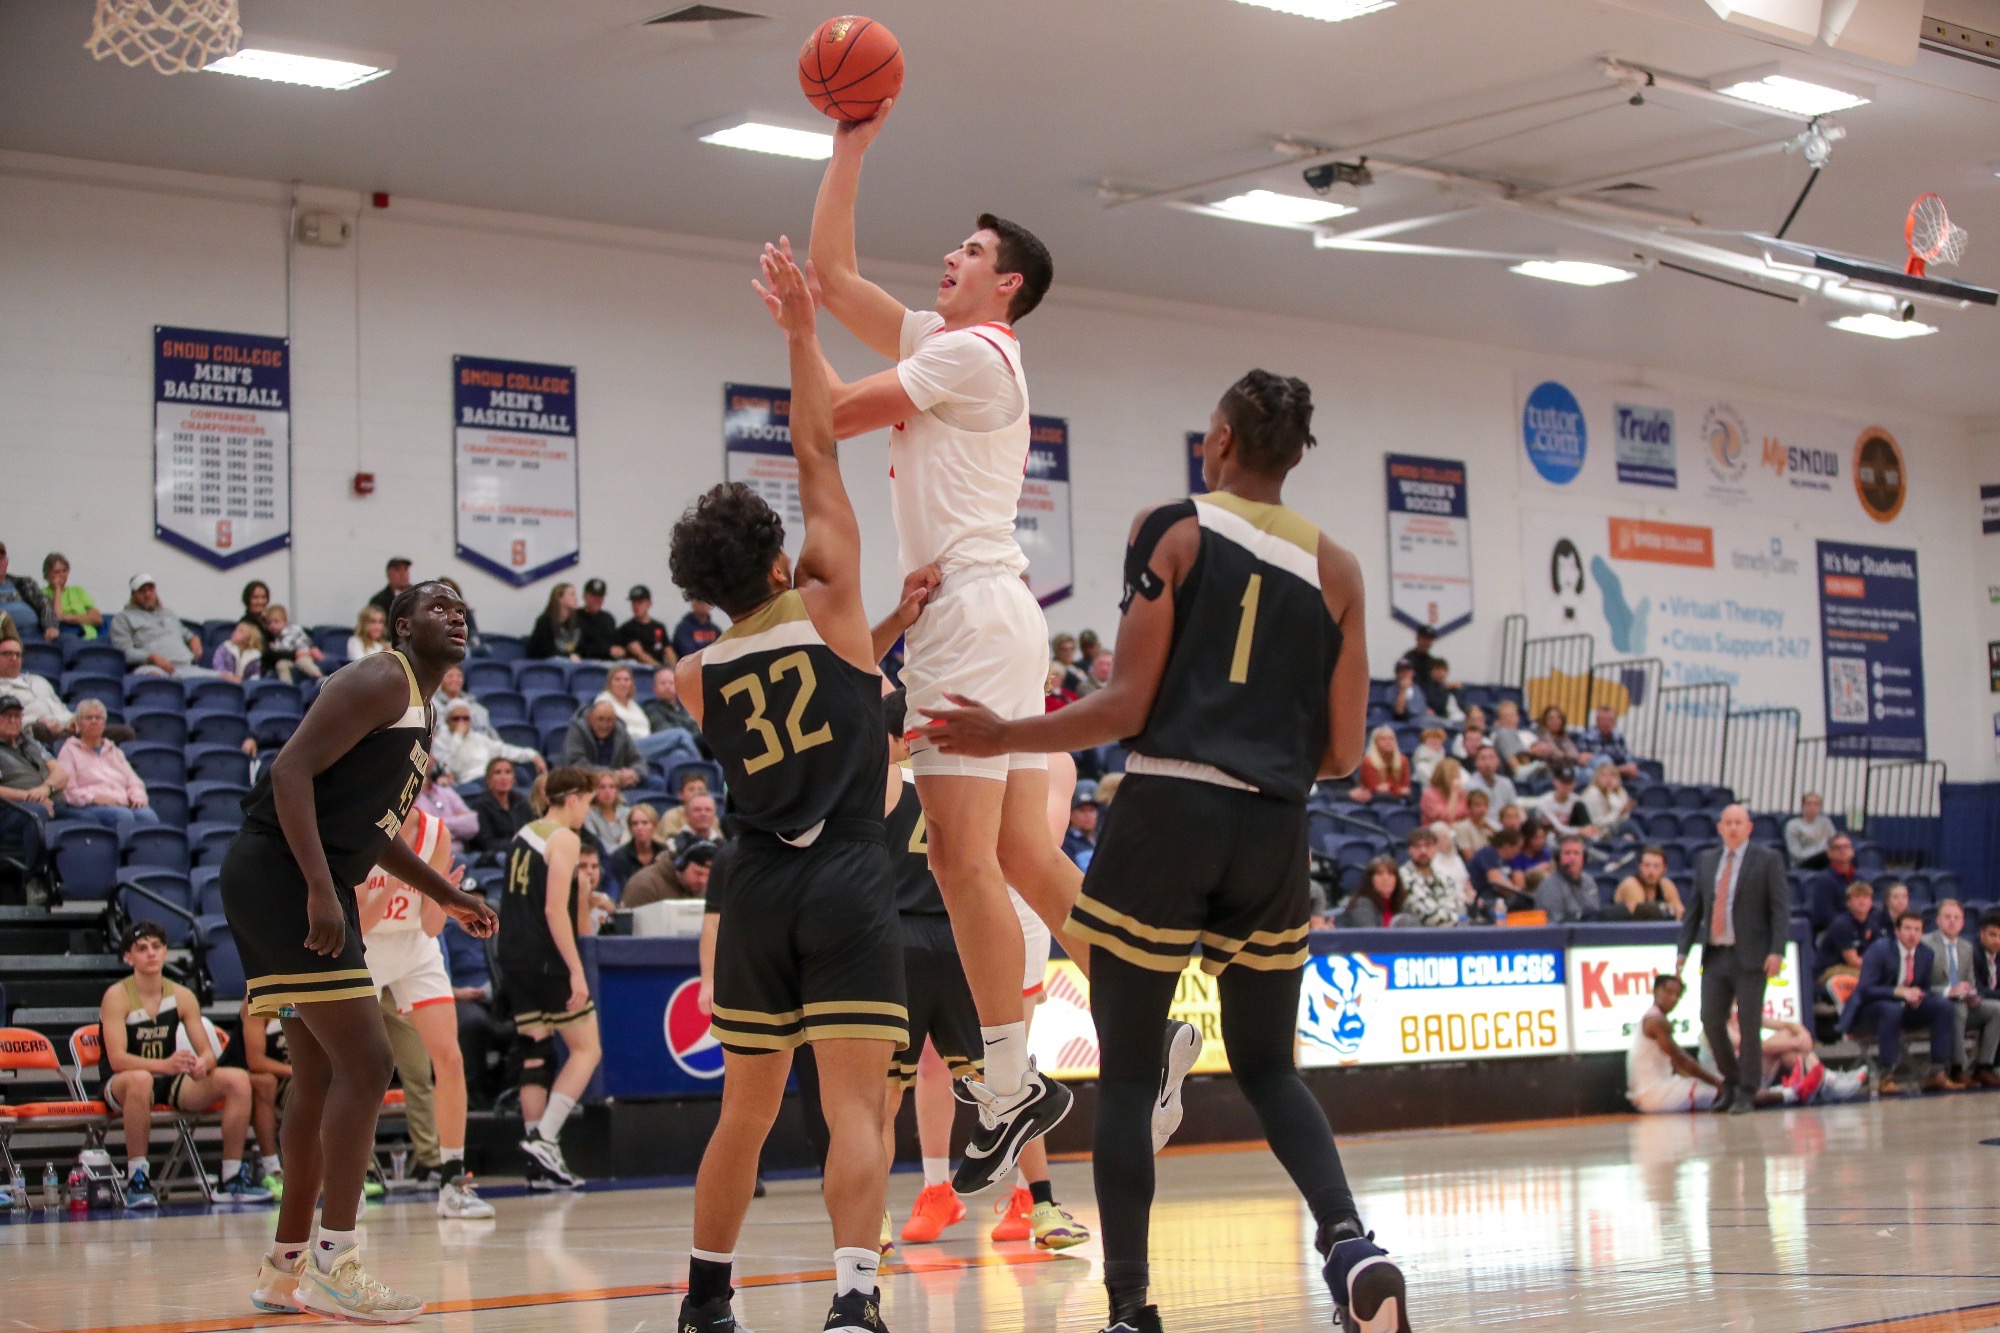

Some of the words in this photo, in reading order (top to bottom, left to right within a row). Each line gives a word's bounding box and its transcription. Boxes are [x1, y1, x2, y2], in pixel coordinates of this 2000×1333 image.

[163, 340, 209, 360] SNOW
[213, 345, 282, 367] COLLEGE
[194, 363, 253, 385] MEN'S
[461, 368, 504, 388] SNOW
[506, 373, 570, 395] COLLEGE
[163, 380, 282, 407] BASKETBALL
[489, 390, 543, 412] MEN'S
[462, 406, 571, 433] BASKETBALL
[1229, 573, 1262, 685] 1
[719, 650, 833, 776] 32
[508, 847, 531, 895] 14
[1394, 956, 1458, 988] SNOW
[1461, 953, 1556, 986] COLLEGE
[1400, 1009, 1557, 1054] BADGERS
